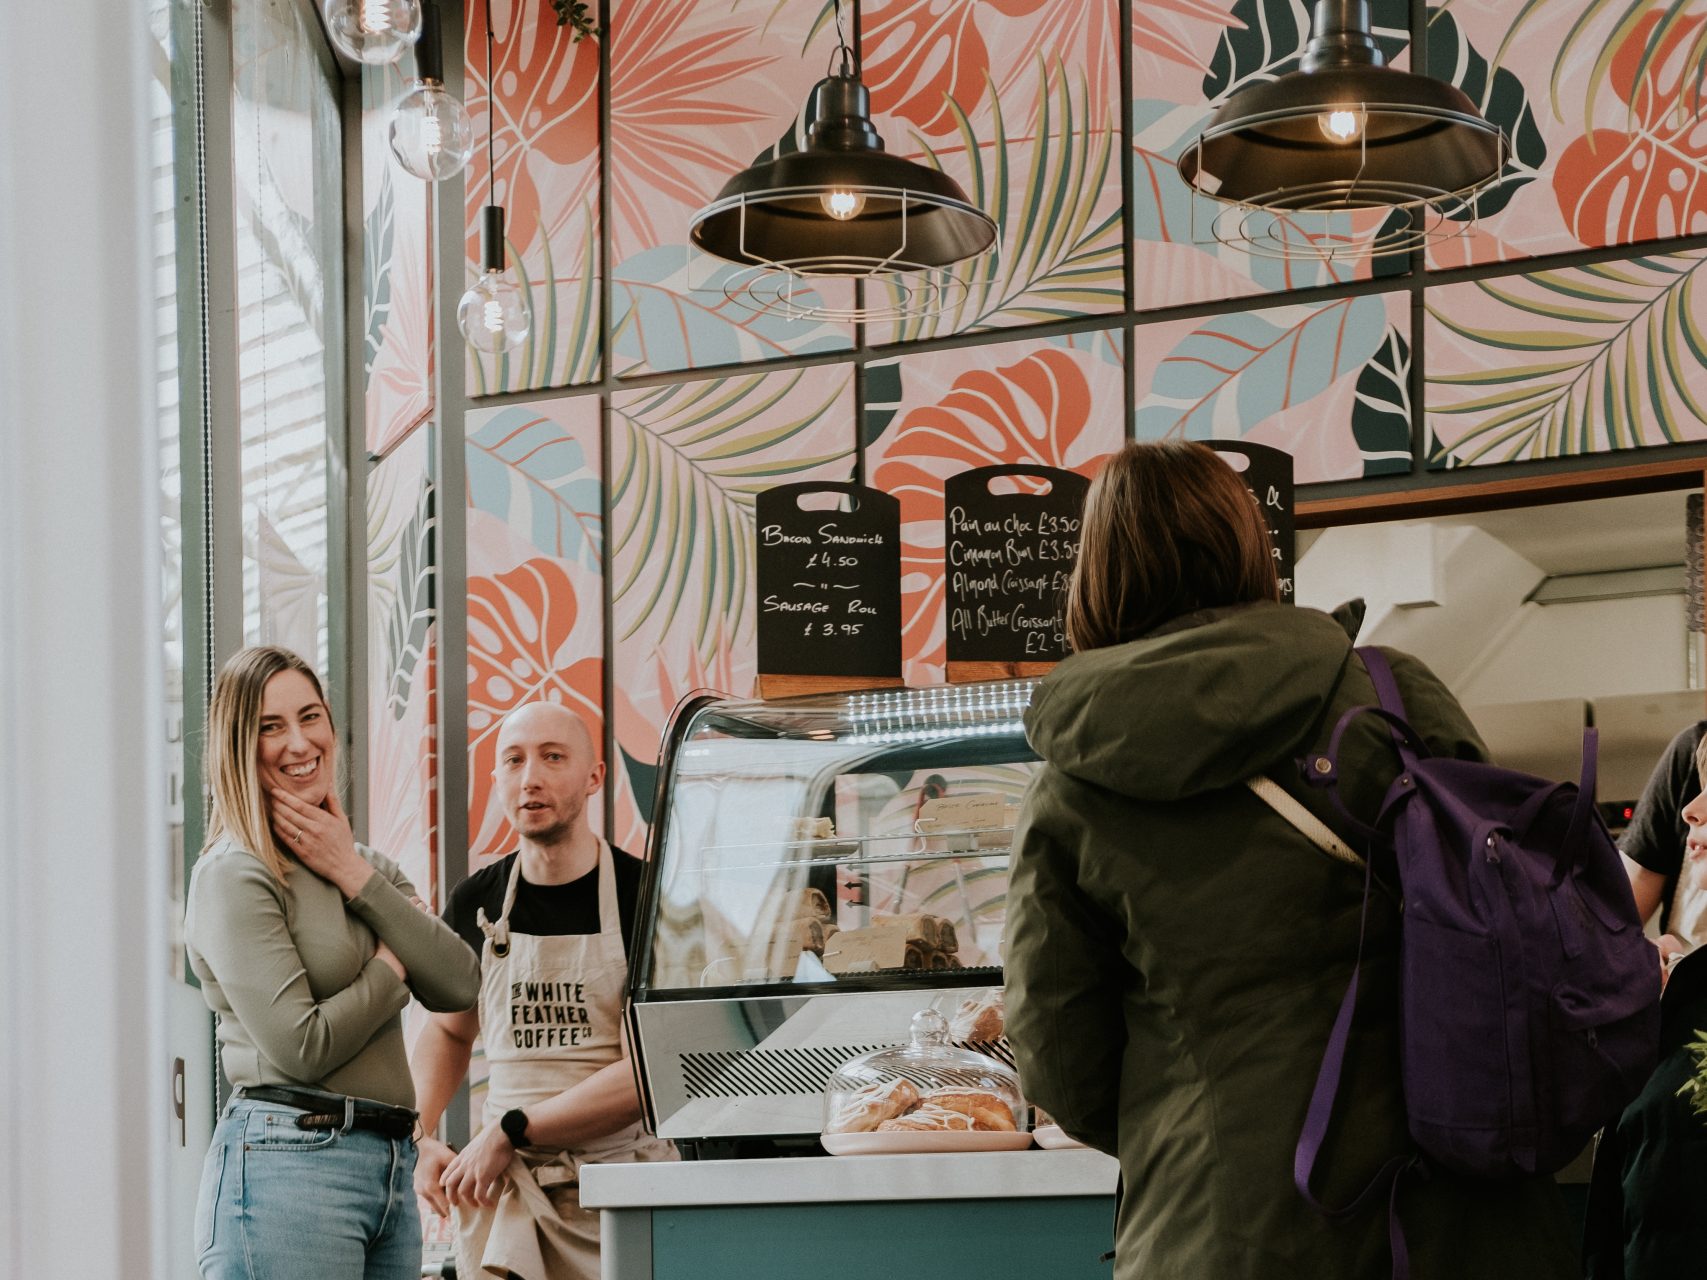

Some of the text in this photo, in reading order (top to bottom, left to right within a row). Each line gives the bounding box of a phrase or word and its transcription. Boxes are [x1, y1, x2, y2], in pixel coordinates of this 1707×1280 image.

[950, 506, 981, 535] Pain
[984, 521, 1000, 532] au
[805, 552, 858, 568] £4.50
[950, 540, 1003, 568] Cinnamon
[1006, 538, 1034, 566] Bun
[953, 571, 999, 602] Almond
[1001, 569, 1048, 600] Croissant
[763, 595, 830, 613] SAUSAGE
[952, 603, 1063, 640] All Butter Croissant
[525, 982, 585, 1003] WHITE
[511, 1005, 590, 1024] FEATHER
[514, 1027, 580, 1049] COFFEE
